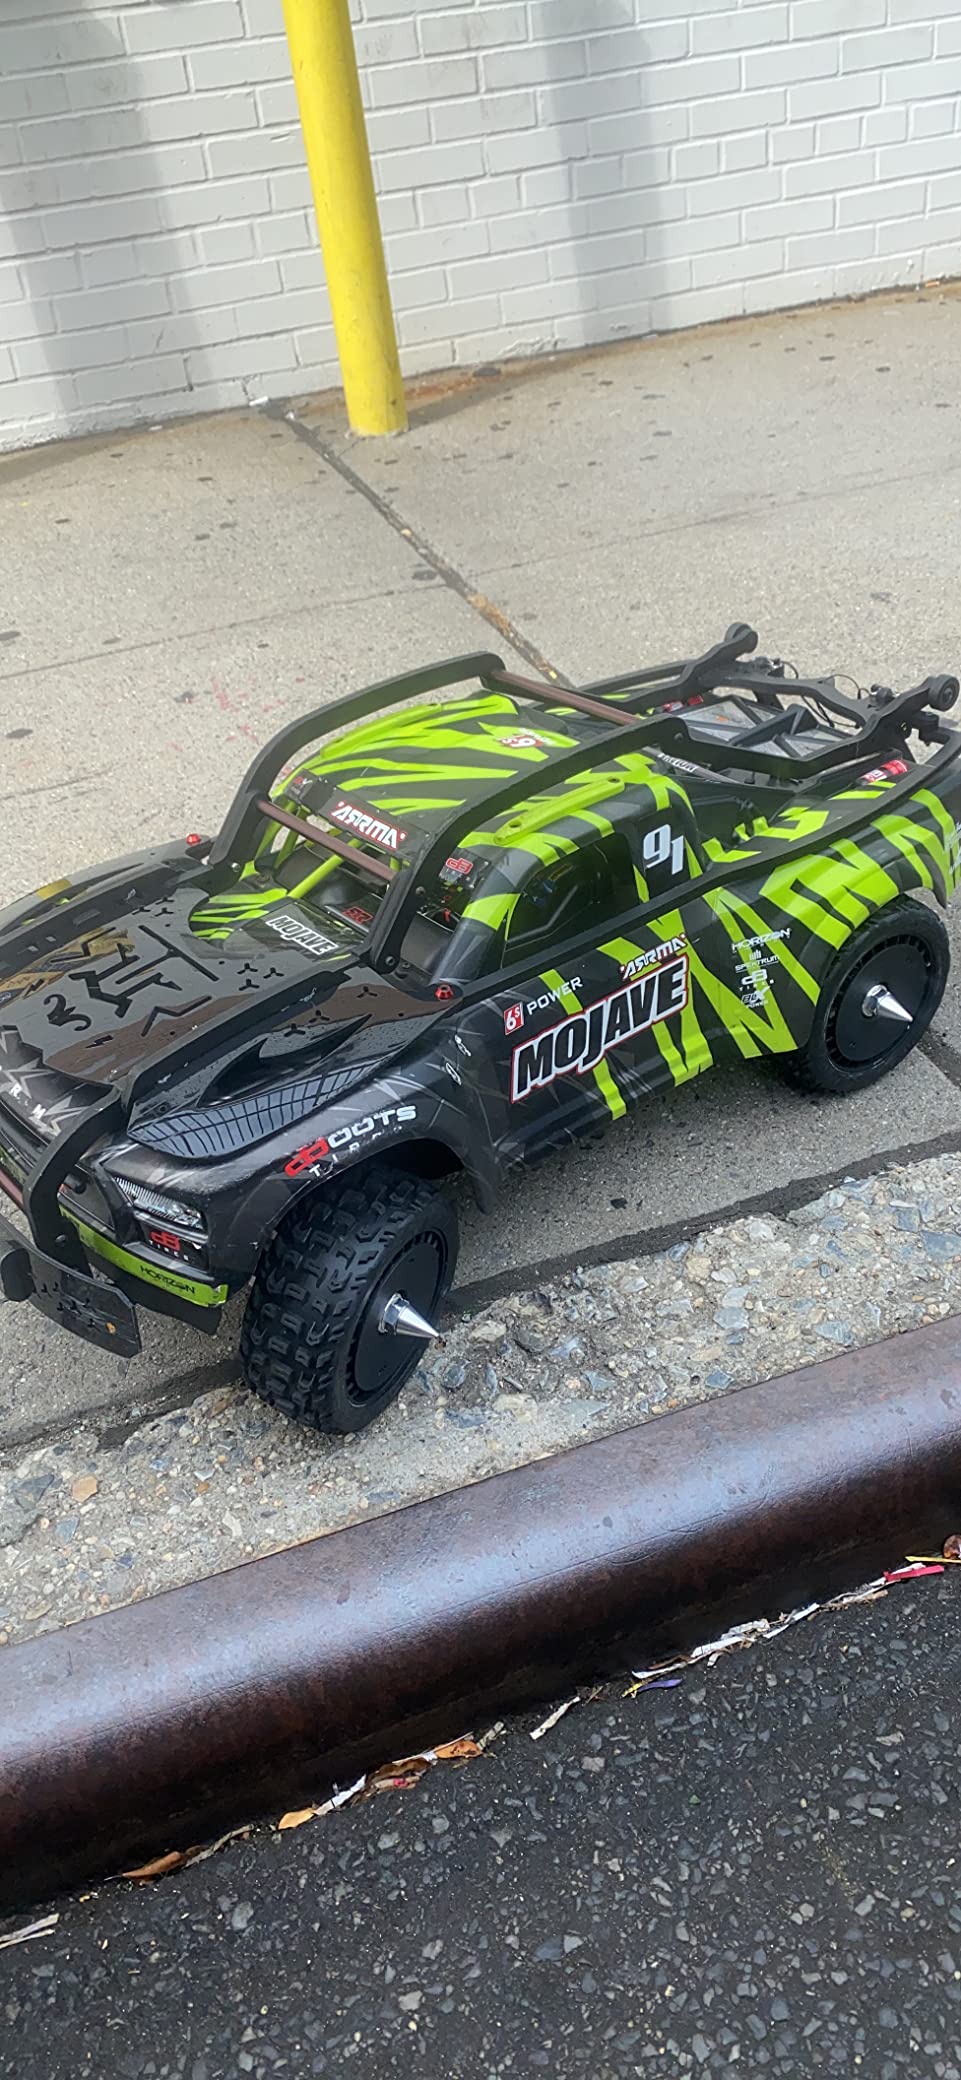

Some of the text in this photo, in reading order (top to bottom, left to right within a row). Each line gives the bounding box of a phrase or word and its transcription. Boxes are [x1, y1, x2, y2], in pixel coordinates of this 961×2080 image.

[643, 823, 685, 876] 91
[265, 914, 339, 956] MOJAVE
[731, 927, 791, 953] HORIZON
[526, 976, 584, 1016] POWER
[511, 953, 690, 1104] MOJAVE
